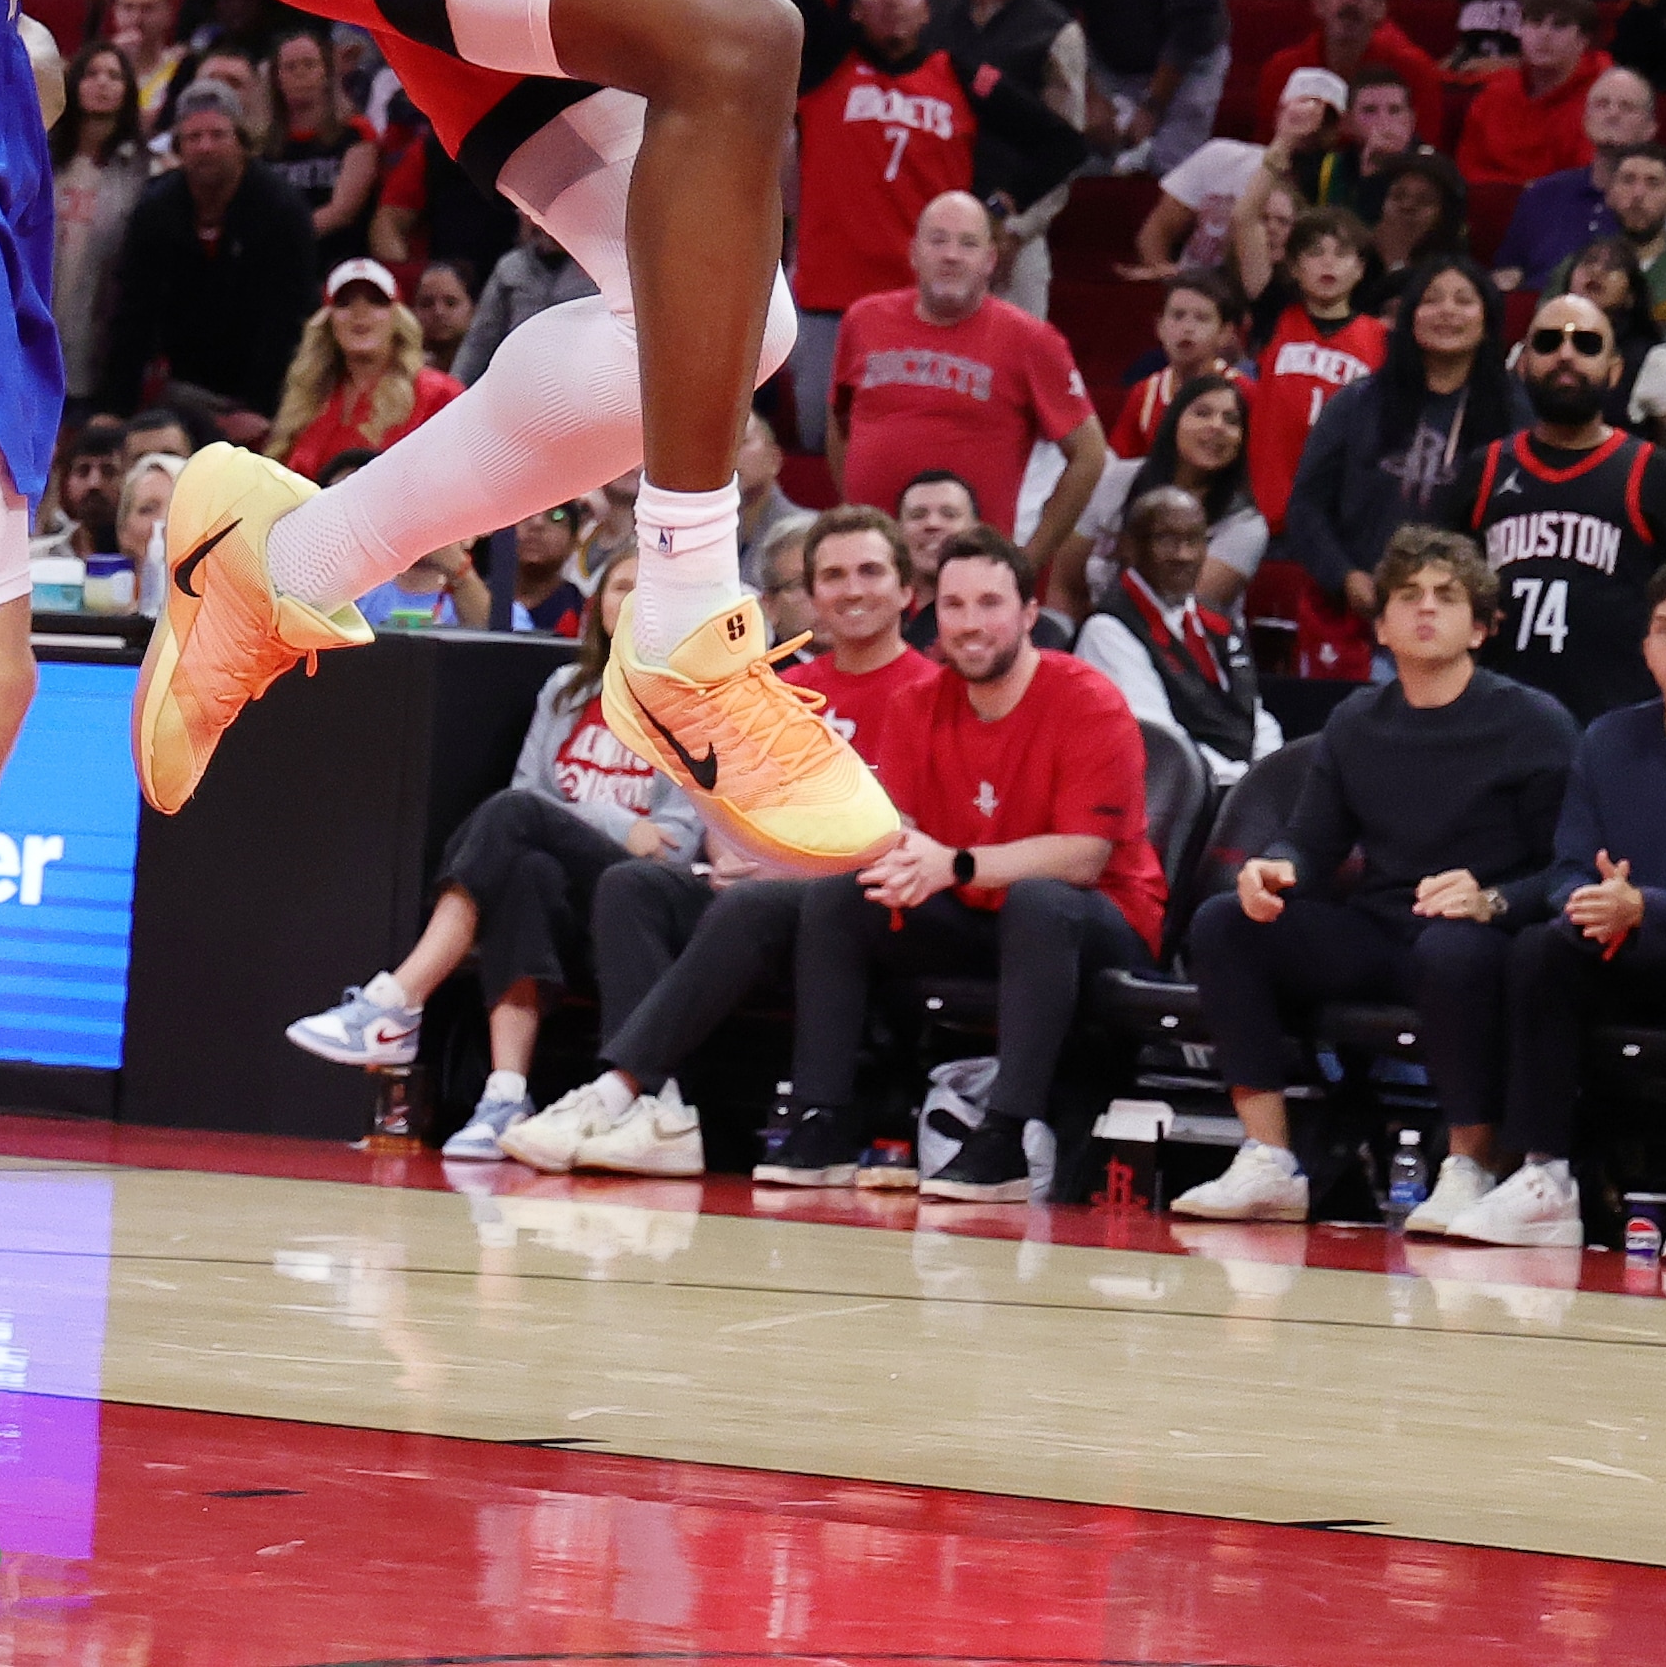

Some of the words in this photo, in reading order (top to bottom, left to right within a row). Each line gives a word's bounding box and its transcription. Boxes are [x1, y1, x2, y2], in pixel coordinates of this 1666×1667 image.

[884, 126, 910, 183] 7
[1486, 509, 1622, 576] HOUSTON
[1511, 577, 1570, 654] 74
